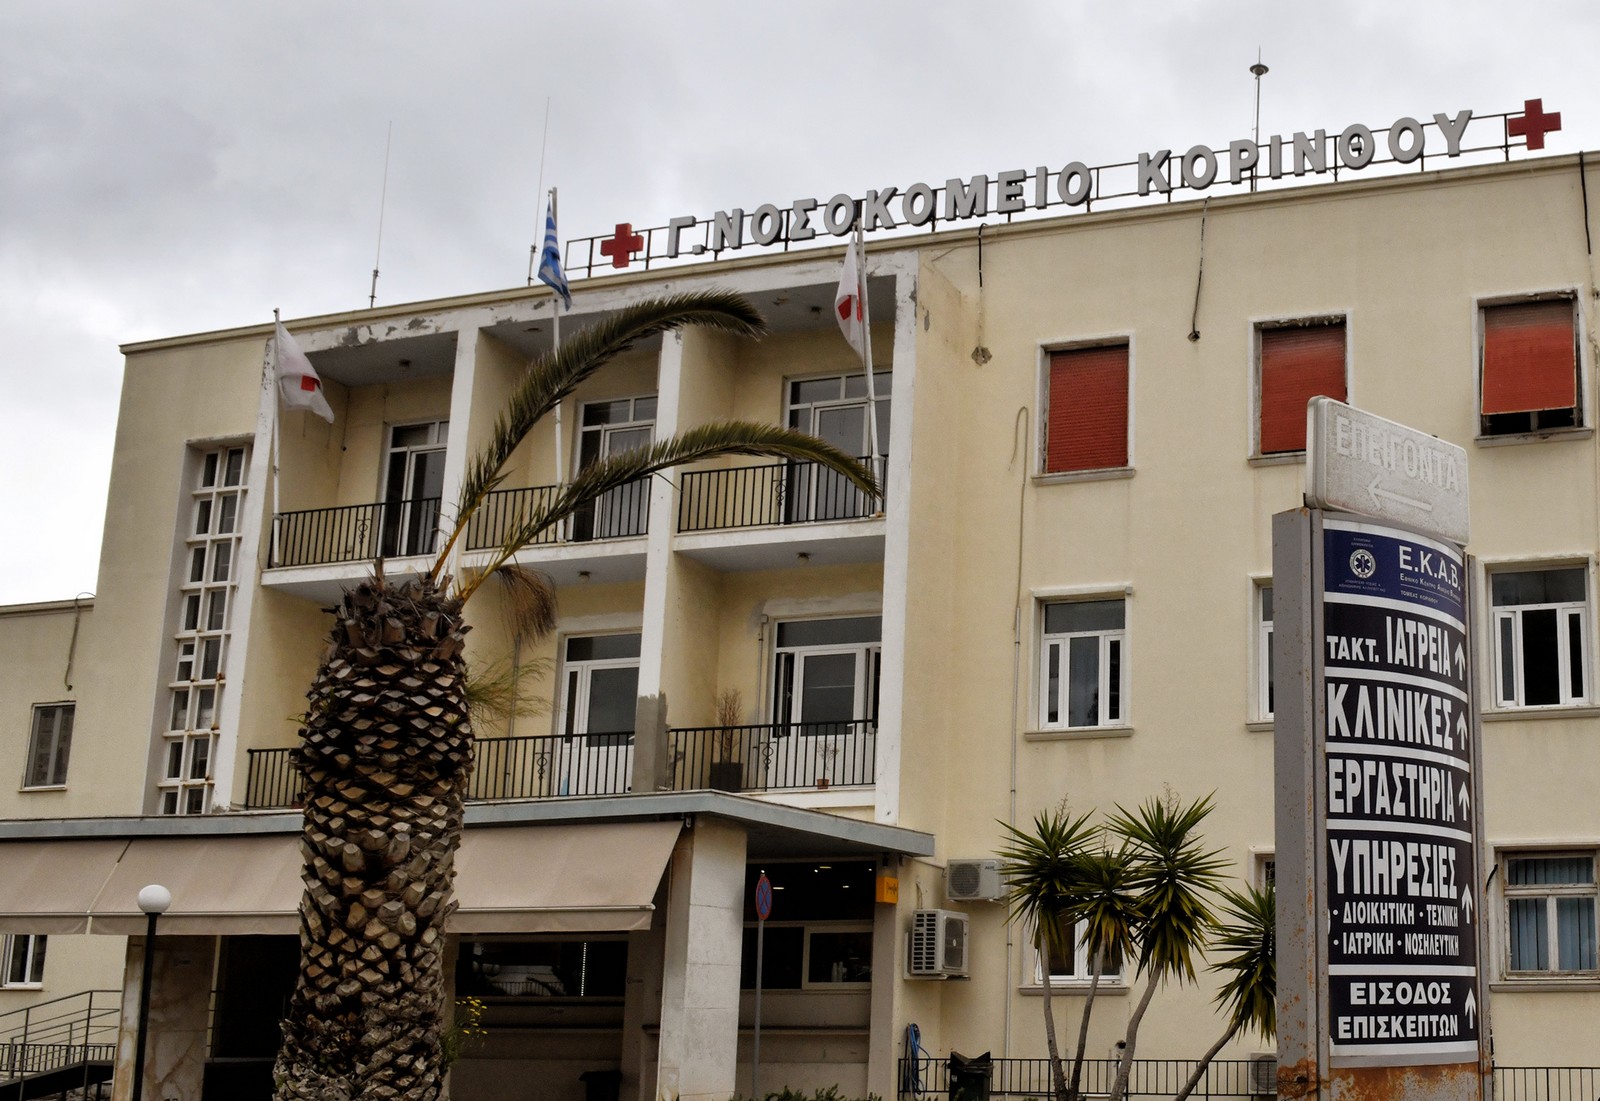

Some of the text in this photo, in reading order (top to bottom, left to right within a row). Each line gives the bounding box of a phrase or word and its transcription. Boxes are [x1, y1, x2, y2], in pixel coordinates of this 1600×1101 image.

[1137, 109, 1473, 196] ΚΟΡΙΝΘΟΥ
[1337, 415, 1461, 494] ΕΠΕΙΓΟΝΤΑ
[1326, 615, 1452, 677] ΤΑΚΤ. ΙΑΤΡΕΙΑ
[1327, 682, 1453, 751] ΚΛΙΝΙΚΕΣ
[1328, 758, 1455, 823] ΕΡΓΑΣΤΗΡΙΑ
[1330, 839, 1458, 900] ΥΠΗΡΕΣΙΕΣ
[1342, 901, 1459, 927] ΔΙΟΙΚΗΤΙΚΗ ΤΕΧΝΙΚΗ
[1343, 932, 1459, 956] ΙΑΤΡΙΚΗ ΝΟΣΗΛΕΥΤΙΚΗ
[1350, 981, 1451, 1005] ΕΙΣΟΔΟΣ
[1337, 1013, 1459, 1039] ΕΠΙΣΚΕΠΤΩΝ
